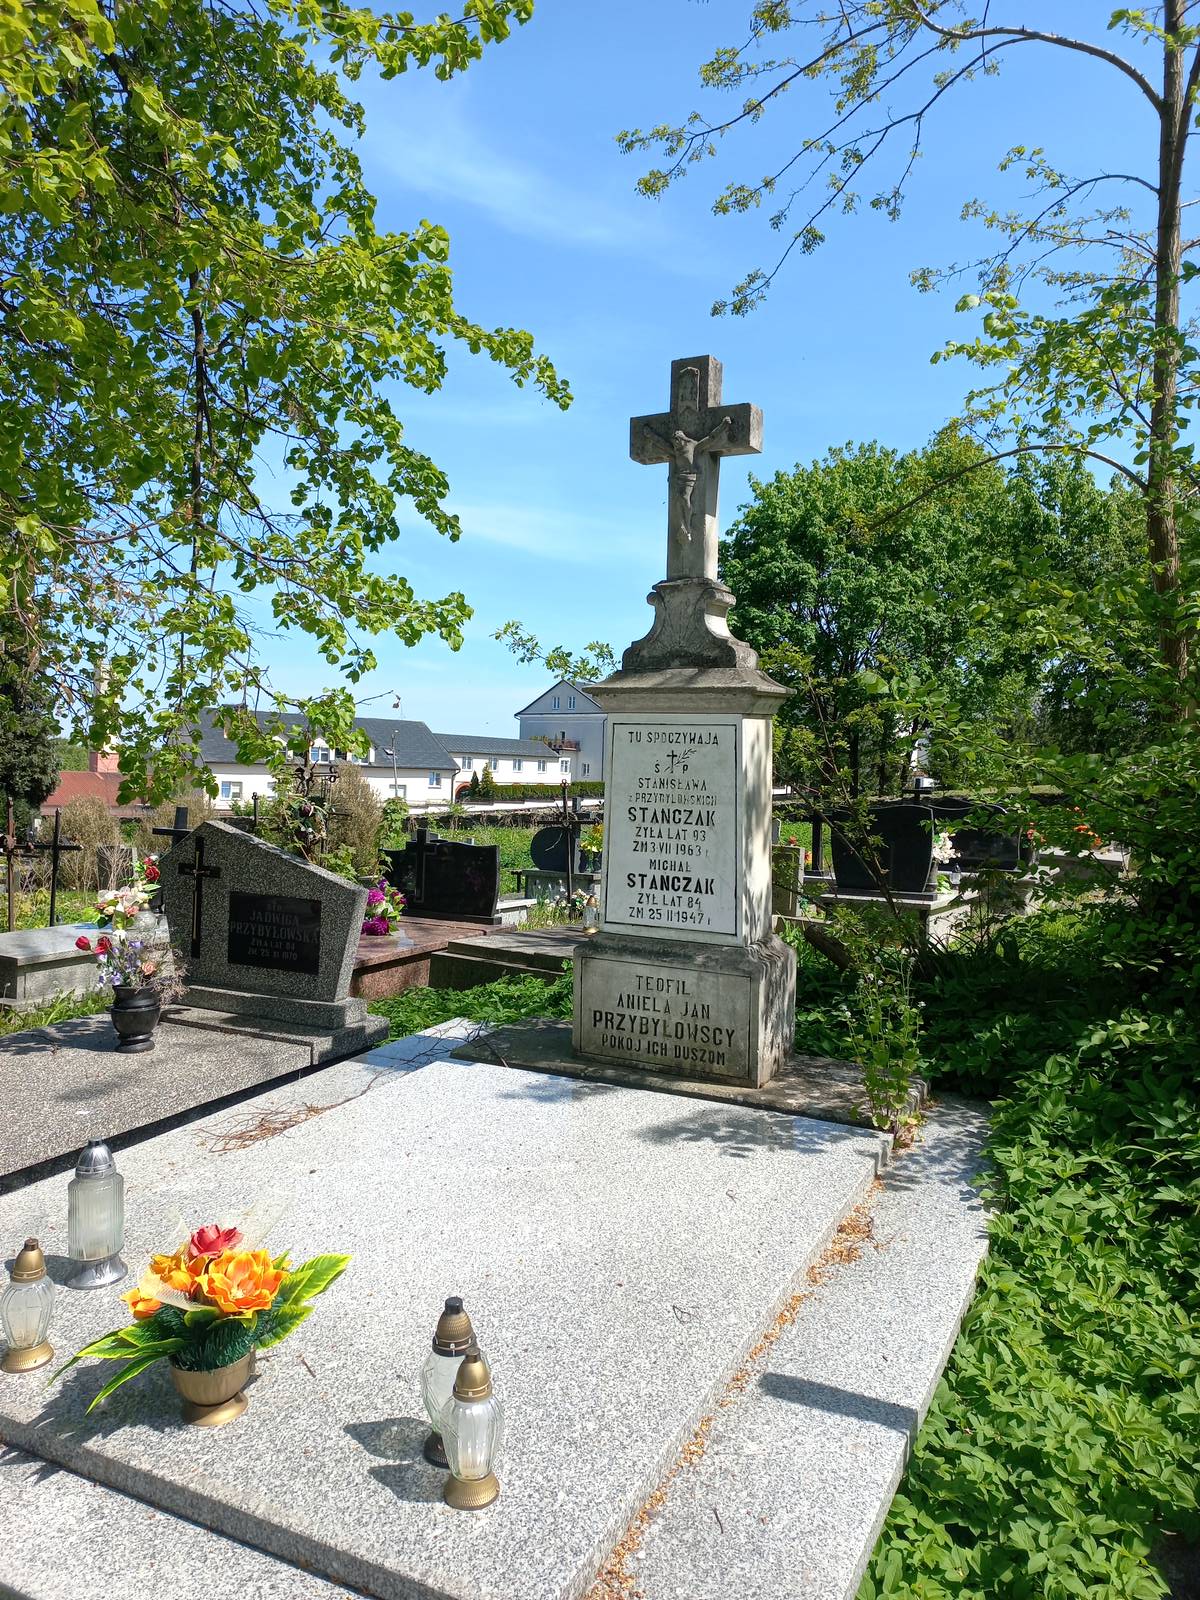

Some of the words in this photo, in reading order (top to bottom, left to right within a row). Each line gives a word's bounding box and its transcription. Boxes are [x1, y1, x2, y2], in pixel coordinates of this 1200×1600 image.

[628, 731, 642, 743] TU
[638, 777, 707, 791] STANISŁAWA
[667, 827, 688, 840] LAT
[693, 830, 706, 842] 93
[649, 859, 692, 872] MICHAŁ
[663, 894, 683, 907] LAT
[687, 896, 701, 909] 84
[249, 909, 300, 926] JADWIGA
[648, 908, 662, 920] 25
[635, 974, 691, 996] TEOFIL
[616, 993, 671, 1015] ANIELA
[679, 1001, 711, 1020] JAN
[646, 1040, 668, 1057] ICH
[674, 1045, 726, 1066] DUSZOM
